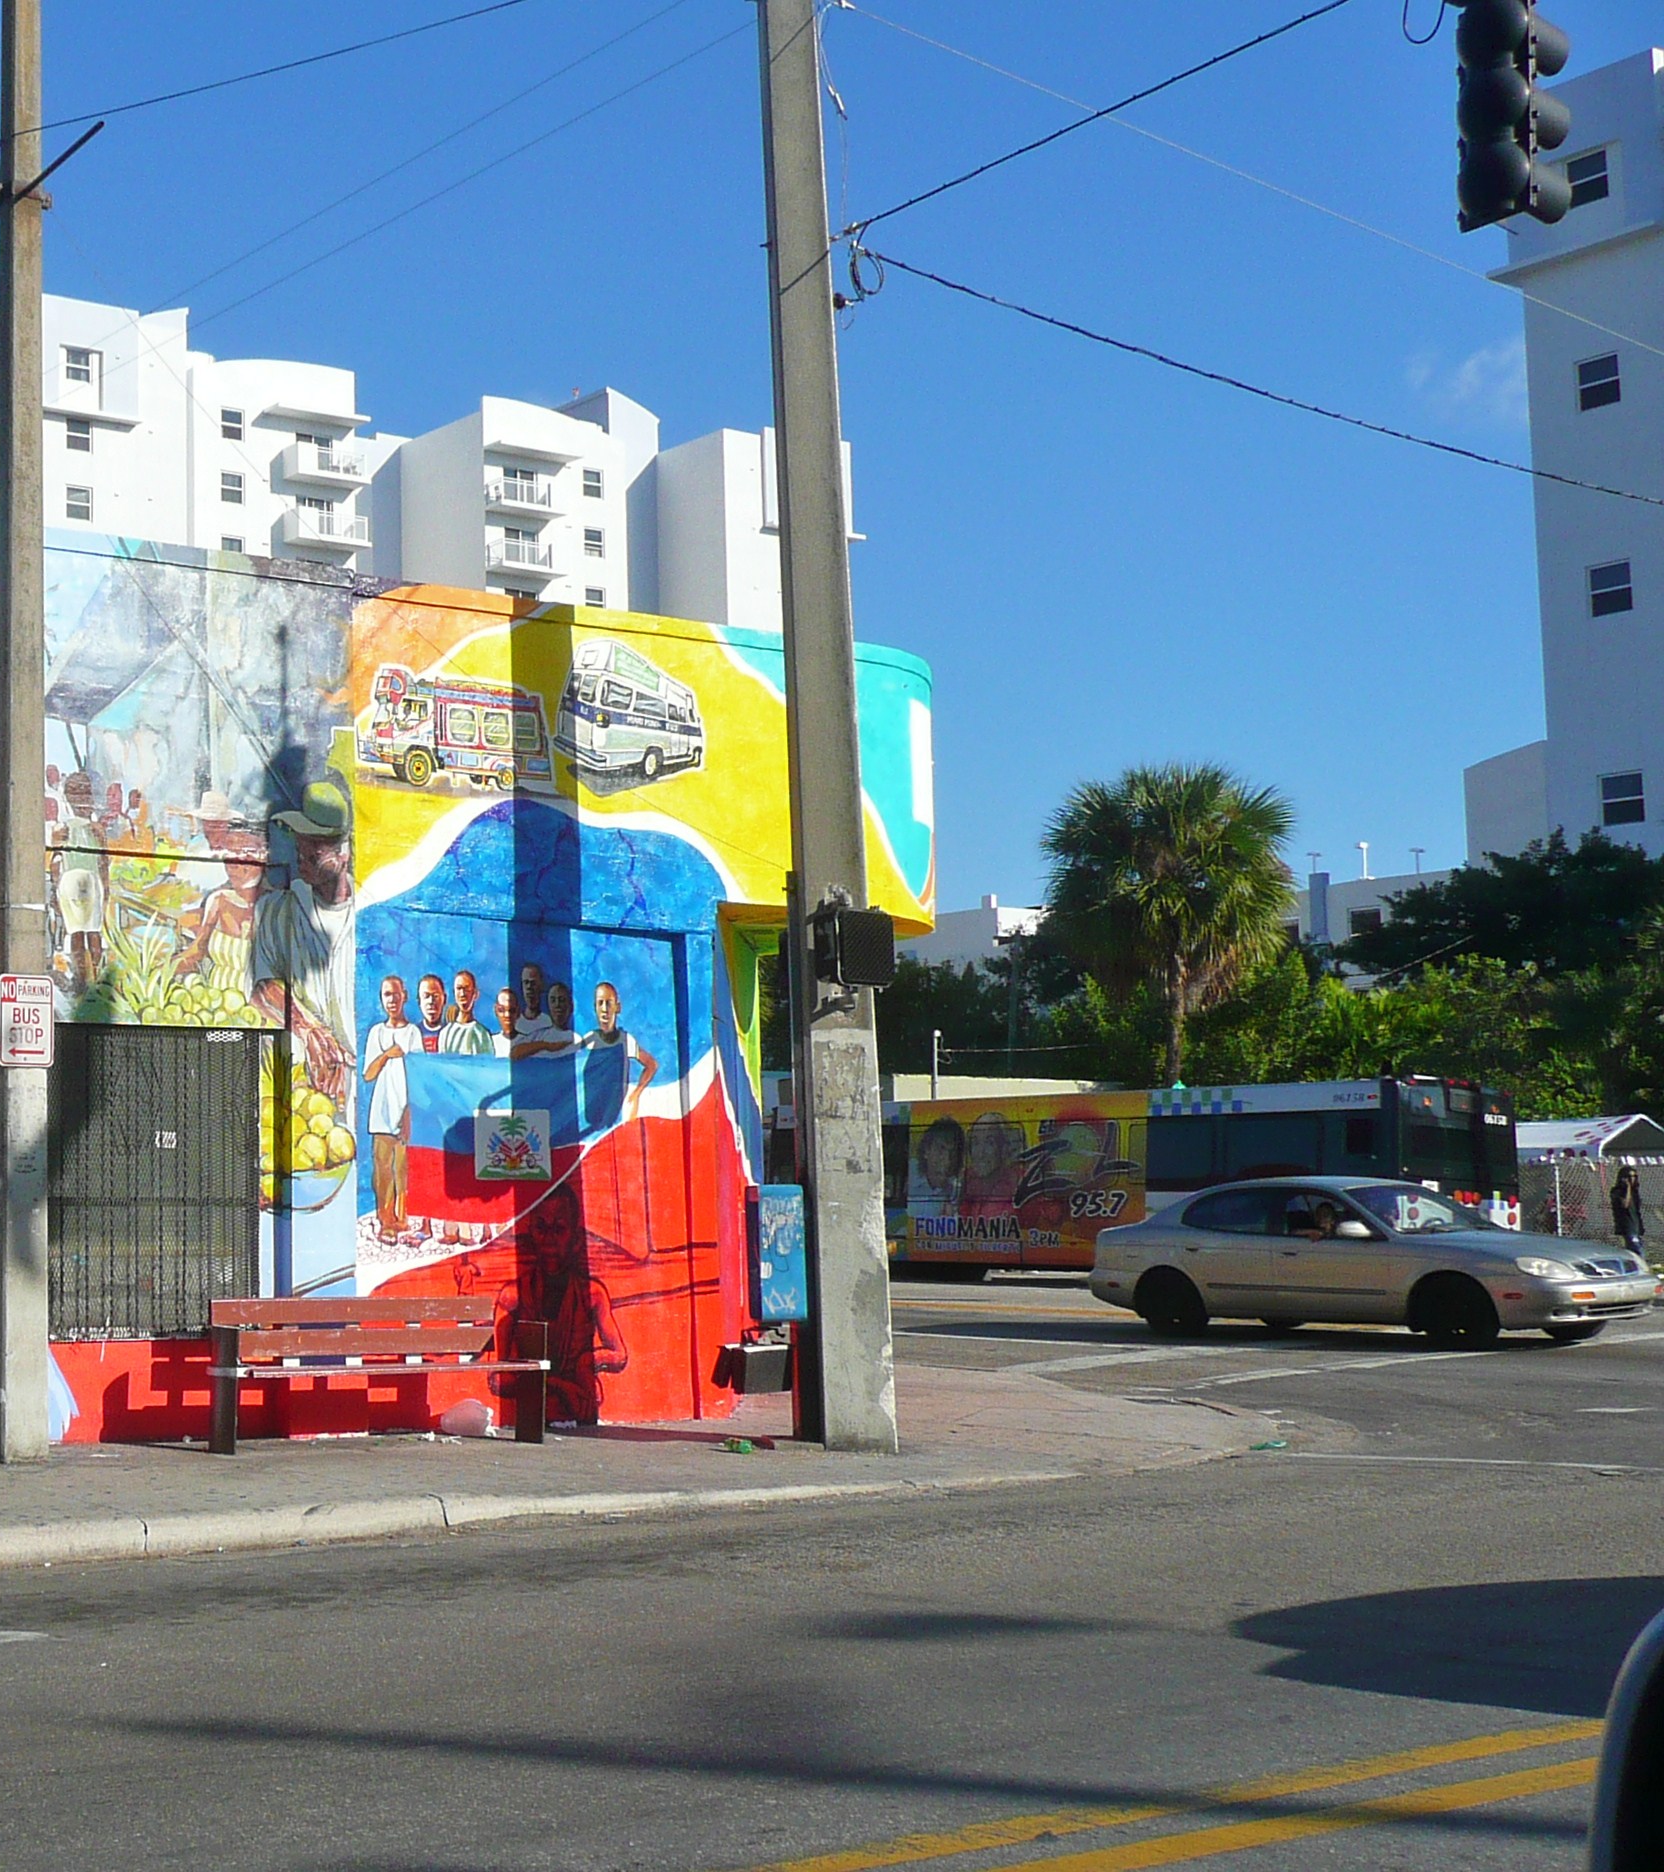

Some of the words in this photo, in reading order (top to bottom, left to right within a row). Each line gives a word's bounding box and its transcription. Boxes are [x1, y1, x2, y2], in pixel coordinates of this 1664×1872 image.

[1, 981, 16, 999] NO
[18, 984, 49, 997] PARKING
[13, 1007, 40, 1024] BUS
[9, 1027, 43, 1044] STOP
[1069, 1190, 1128, 1218] 95.7
